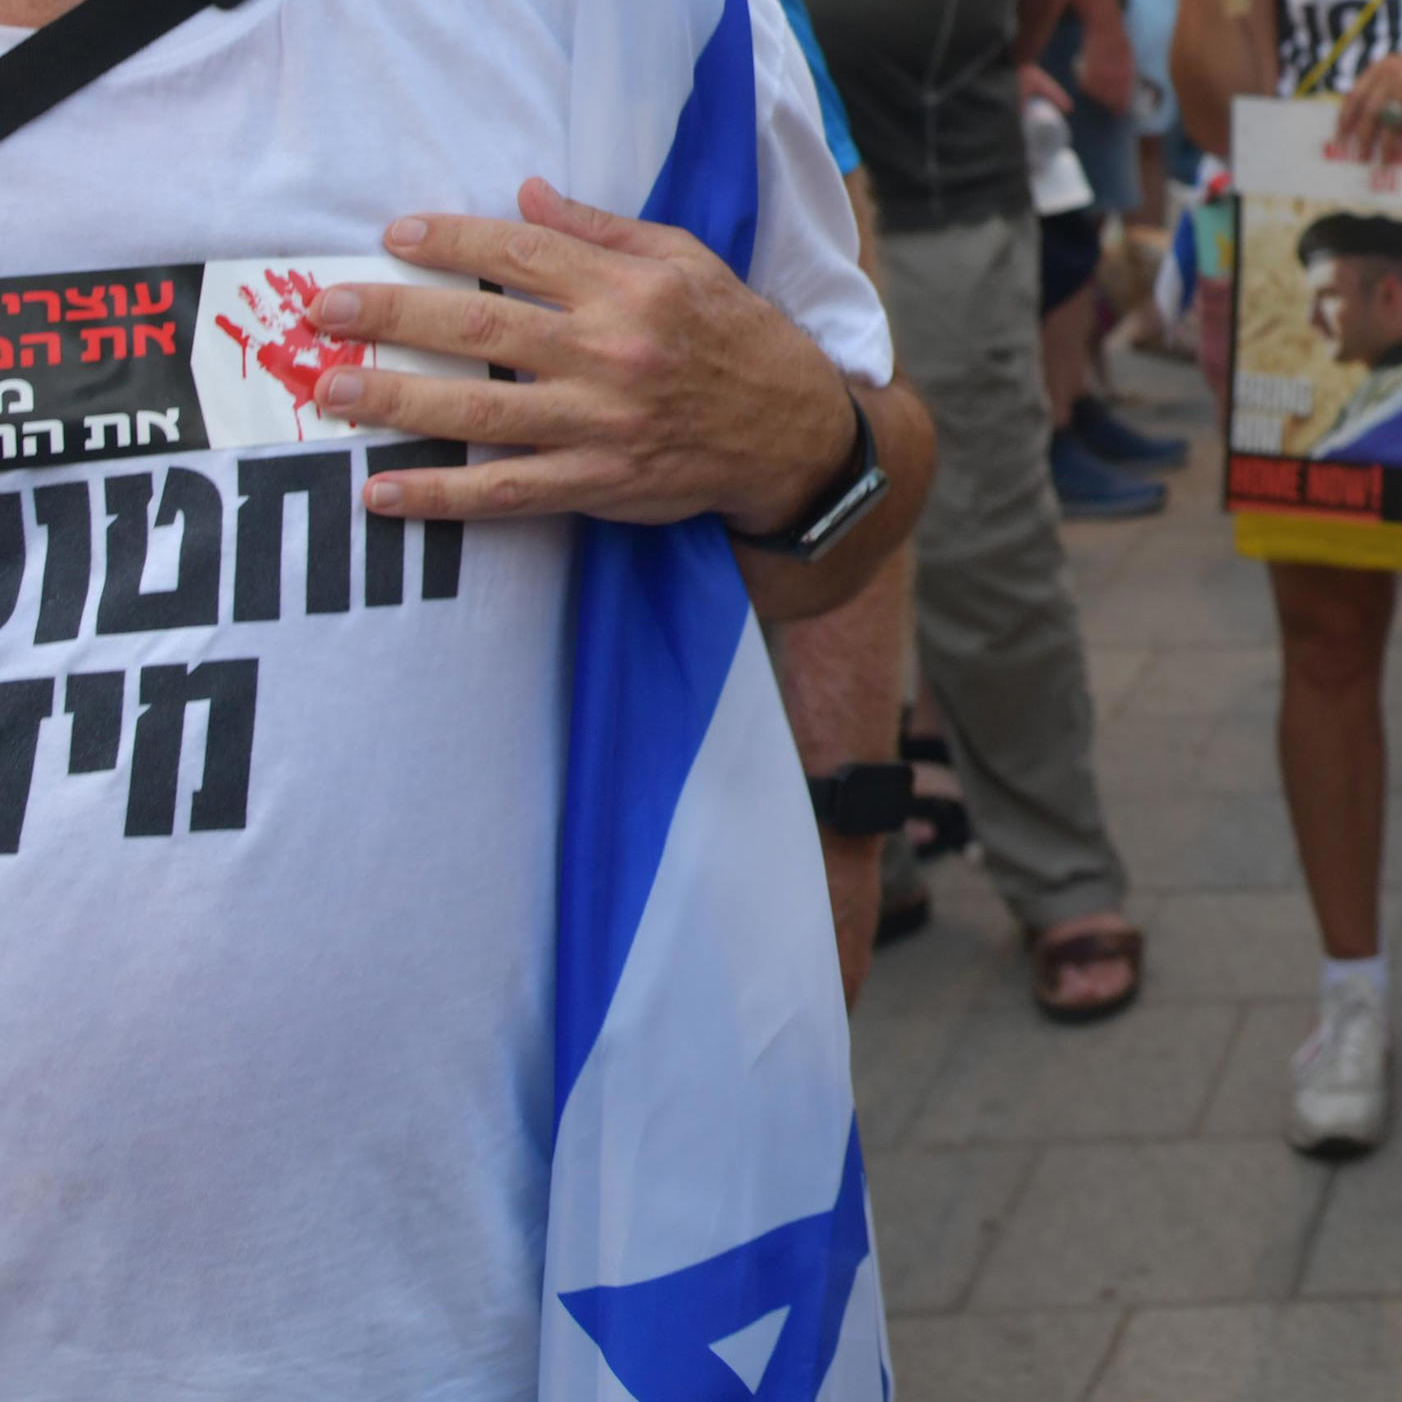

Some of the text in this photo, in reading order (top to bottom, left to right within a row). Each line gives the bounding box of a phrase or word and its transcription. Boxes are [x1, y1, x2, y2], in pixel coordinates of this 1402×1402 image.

[0, 280, 175, 324] עוצרי
[79, 320, 177, 364] את
[83, 406, 181, 452] את
[0, 439, 468, 646] החטו
